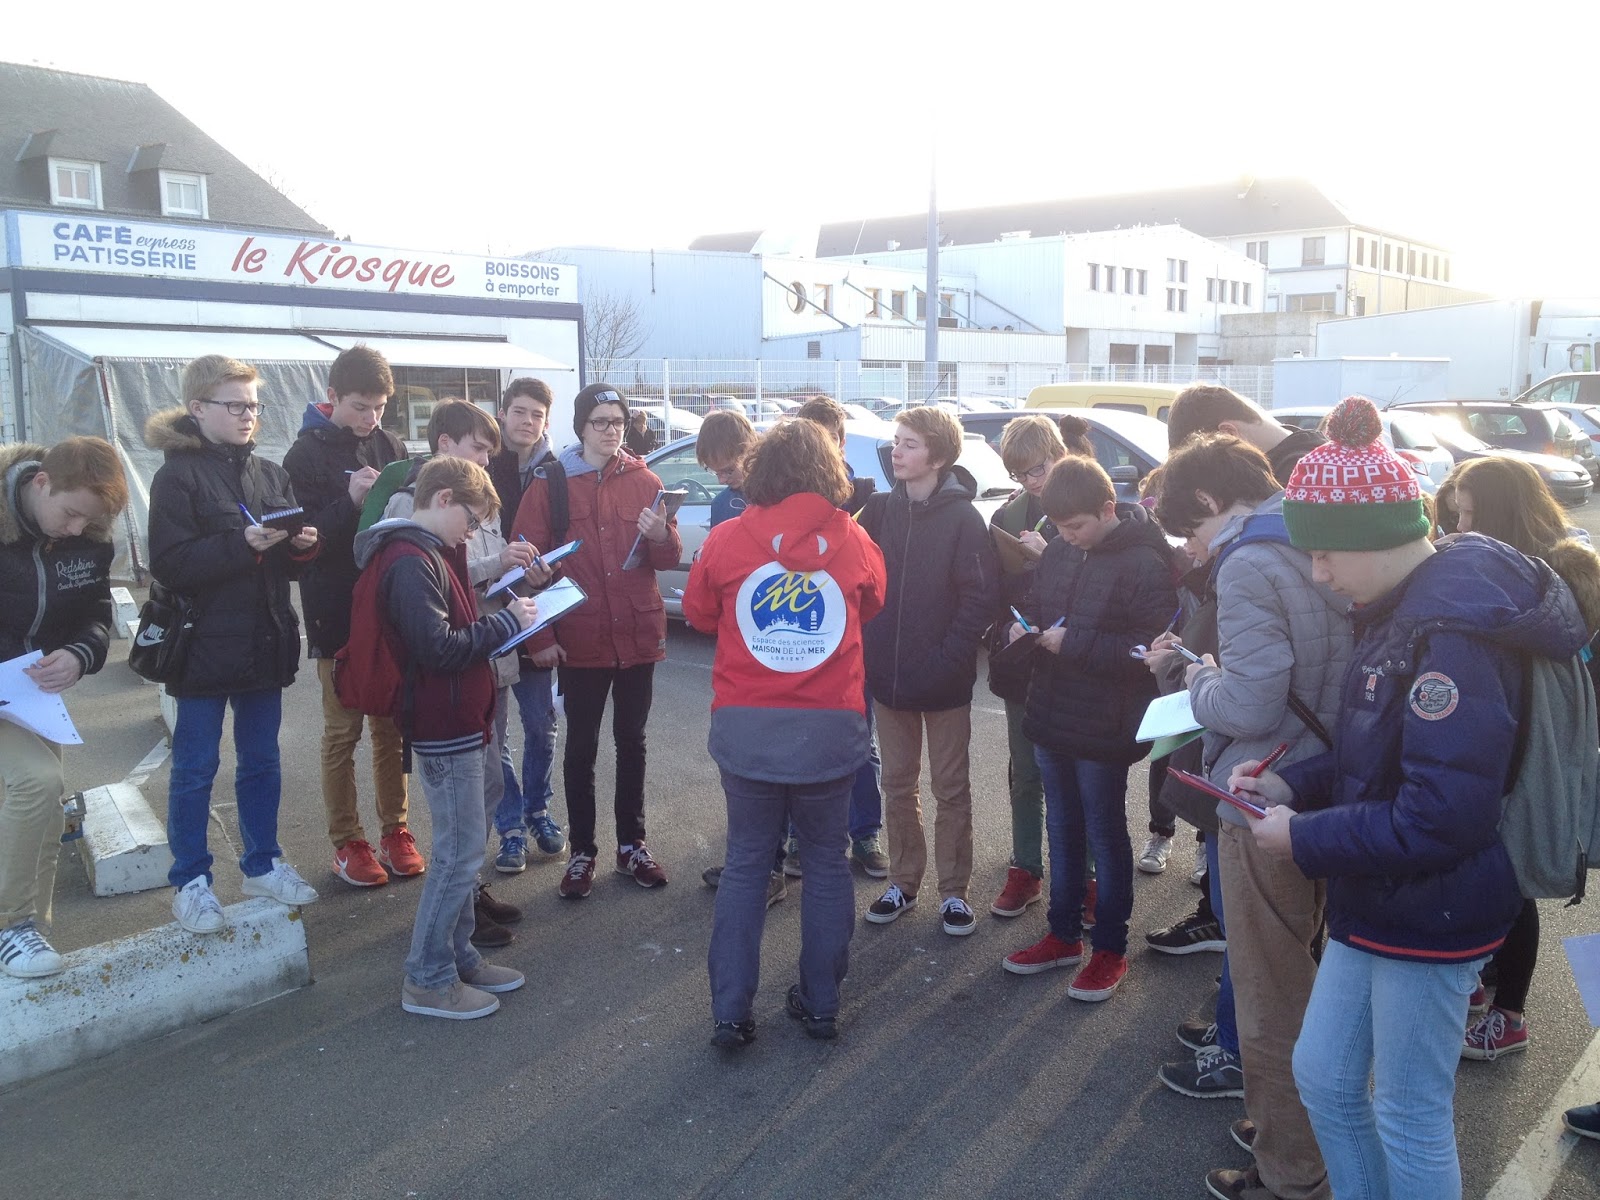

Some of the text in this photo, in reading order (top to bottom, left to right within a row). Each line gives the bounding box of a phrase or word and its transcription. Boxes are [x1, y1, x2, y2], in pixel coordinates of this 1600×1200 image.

[53, 222, 196, 250] CAFÉ express
[54, 244, 196, 270] PATISSERIE
[231, 237, 455, 292] le Kiosque
[485, 261, 560, 281] BOISSONS
[485, 278, 560, 298] à emporter
[1301, 463, 1399, 486] HAPPY
[751, 644, 826, 655] MAISON DE LA MER
[752, 636, 776, 645] Espace
